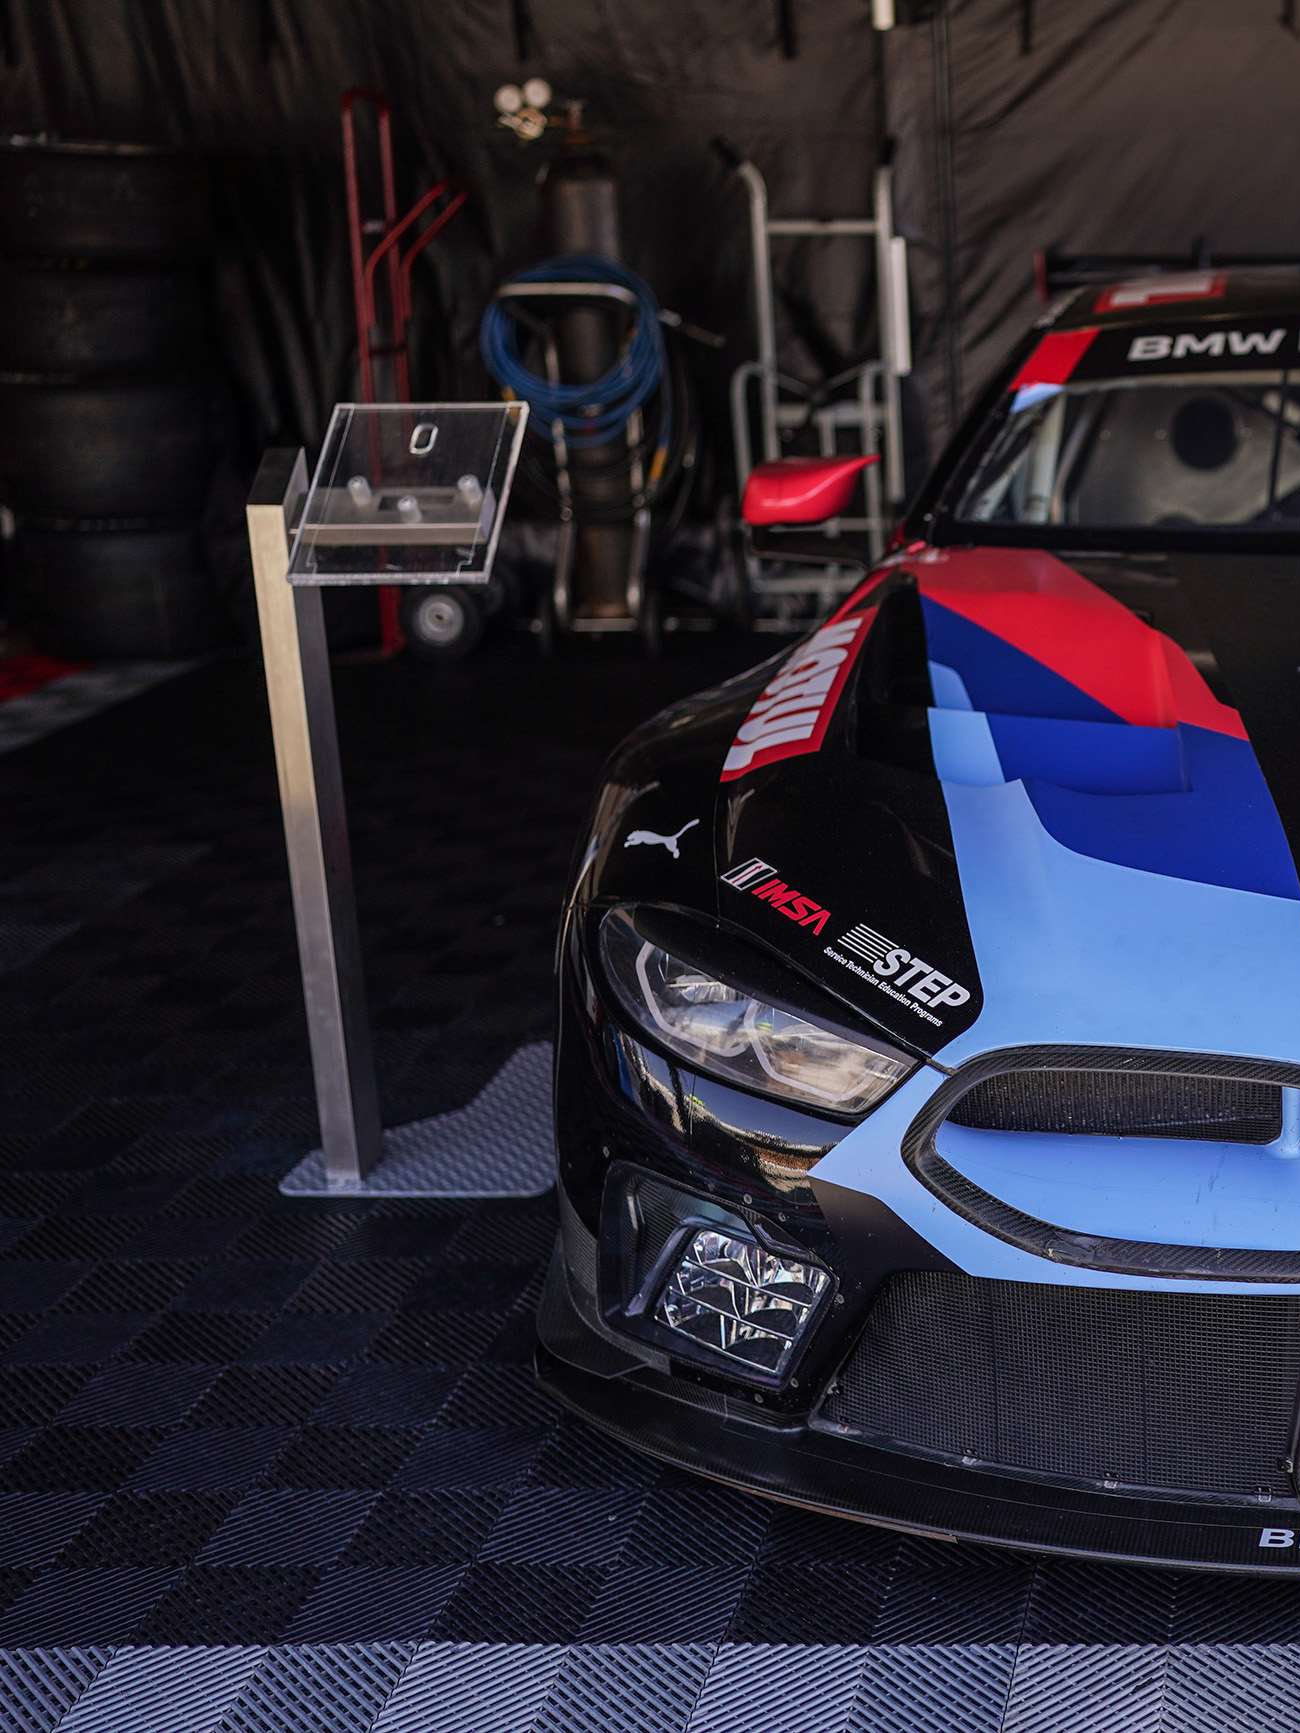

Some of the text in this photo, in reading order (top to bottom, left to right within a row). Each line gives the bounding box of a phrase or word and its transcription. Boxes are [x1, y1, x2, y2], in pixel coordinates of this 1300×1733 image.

[1127, 329, 1287, 361] BMW
[751, 878, 832, 936] IMSA
[823, 946, 943, 1027] Service Technician Education Programs
[873, 948, 971, 1008] STEP
